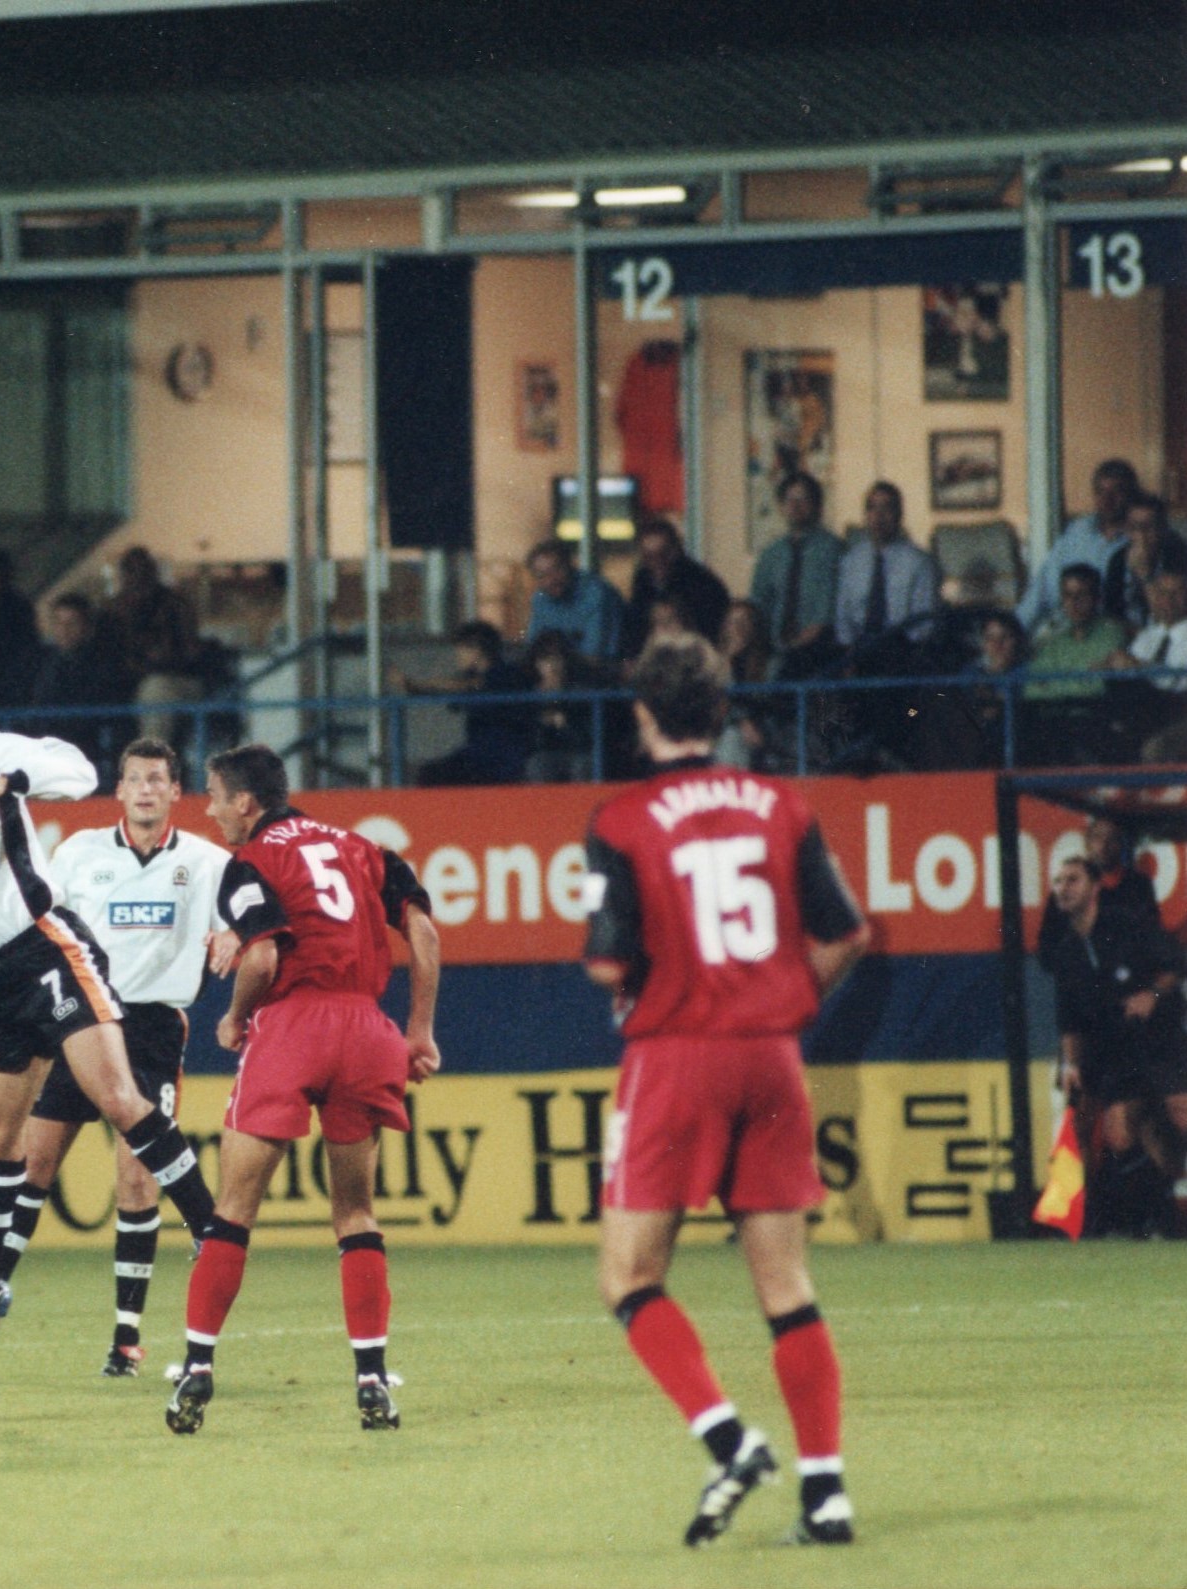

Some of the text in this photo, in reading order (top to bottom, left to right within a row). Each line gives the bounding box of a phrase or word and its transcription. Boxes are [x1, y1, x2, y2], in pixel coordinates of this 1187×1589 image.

[612, 257, 674, 321] 12
[1078, 232, 1145, 298] 13
[298, 841, 354, 922] 5
[671, 835, 778, 964] 15
[113, 905, 172, 924] SKF
[40, 968, 63, 1008] 7
[159, 1082, 176, 1118] 8
